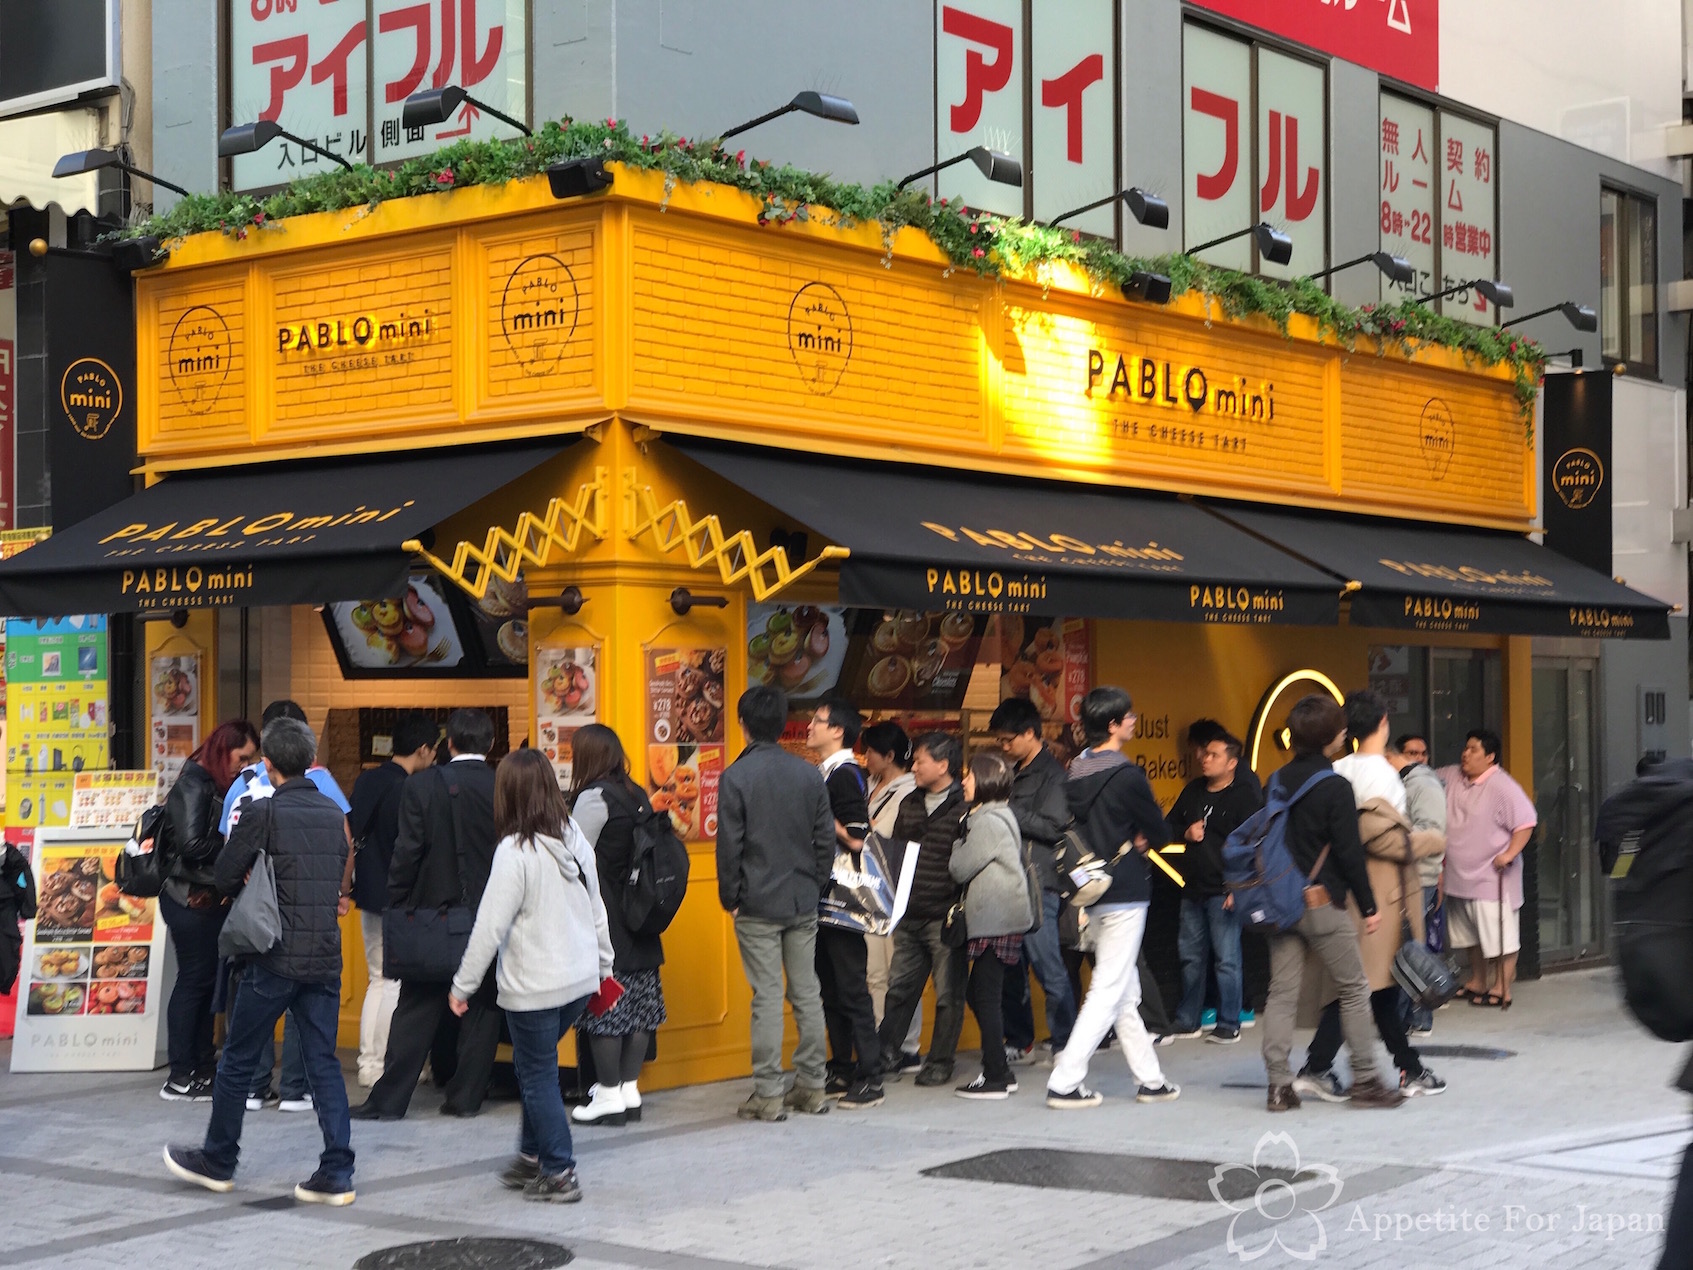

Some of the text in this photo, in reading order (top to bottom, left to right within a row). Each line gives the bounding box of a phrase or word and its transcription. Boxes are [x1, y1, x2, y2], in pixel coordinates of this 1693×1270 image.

[942, 5, 1319, 222] アイフル
[513, 297, 564, 331] mini
[279, 309, 431, 353] PABLO mini
[798, 325, 841, 353] mini
[178, 346, 220, 374] mini
[77, 372, 106, 387] PABLO
[1087, 349, 1275, 420] PABLO mini
[70, 387, 111, 409] mini
[1113, 418, 1139, 435] THE
[1151, 424, 1205, 445] CHEESE
[1560, 468, 1596, 486] mini
[98, 499, 416, 545] PABLO mini
[121, 564, 253, 594] PABLO mini
[926, 568, 1047, 600] PABLO mini
[138, 598, 156, 608] THE
[161, 596, 203, 607] CHEESE
[1190, 584, 1284, 612] PABLO mini
[1404, 595, 1480, 620] PABLO mini
[1569, 607, 1609, 628] PABLO
[1135, 713, 1170, 739] Just
[31, 1031, 139, 1048] PABLO mini
